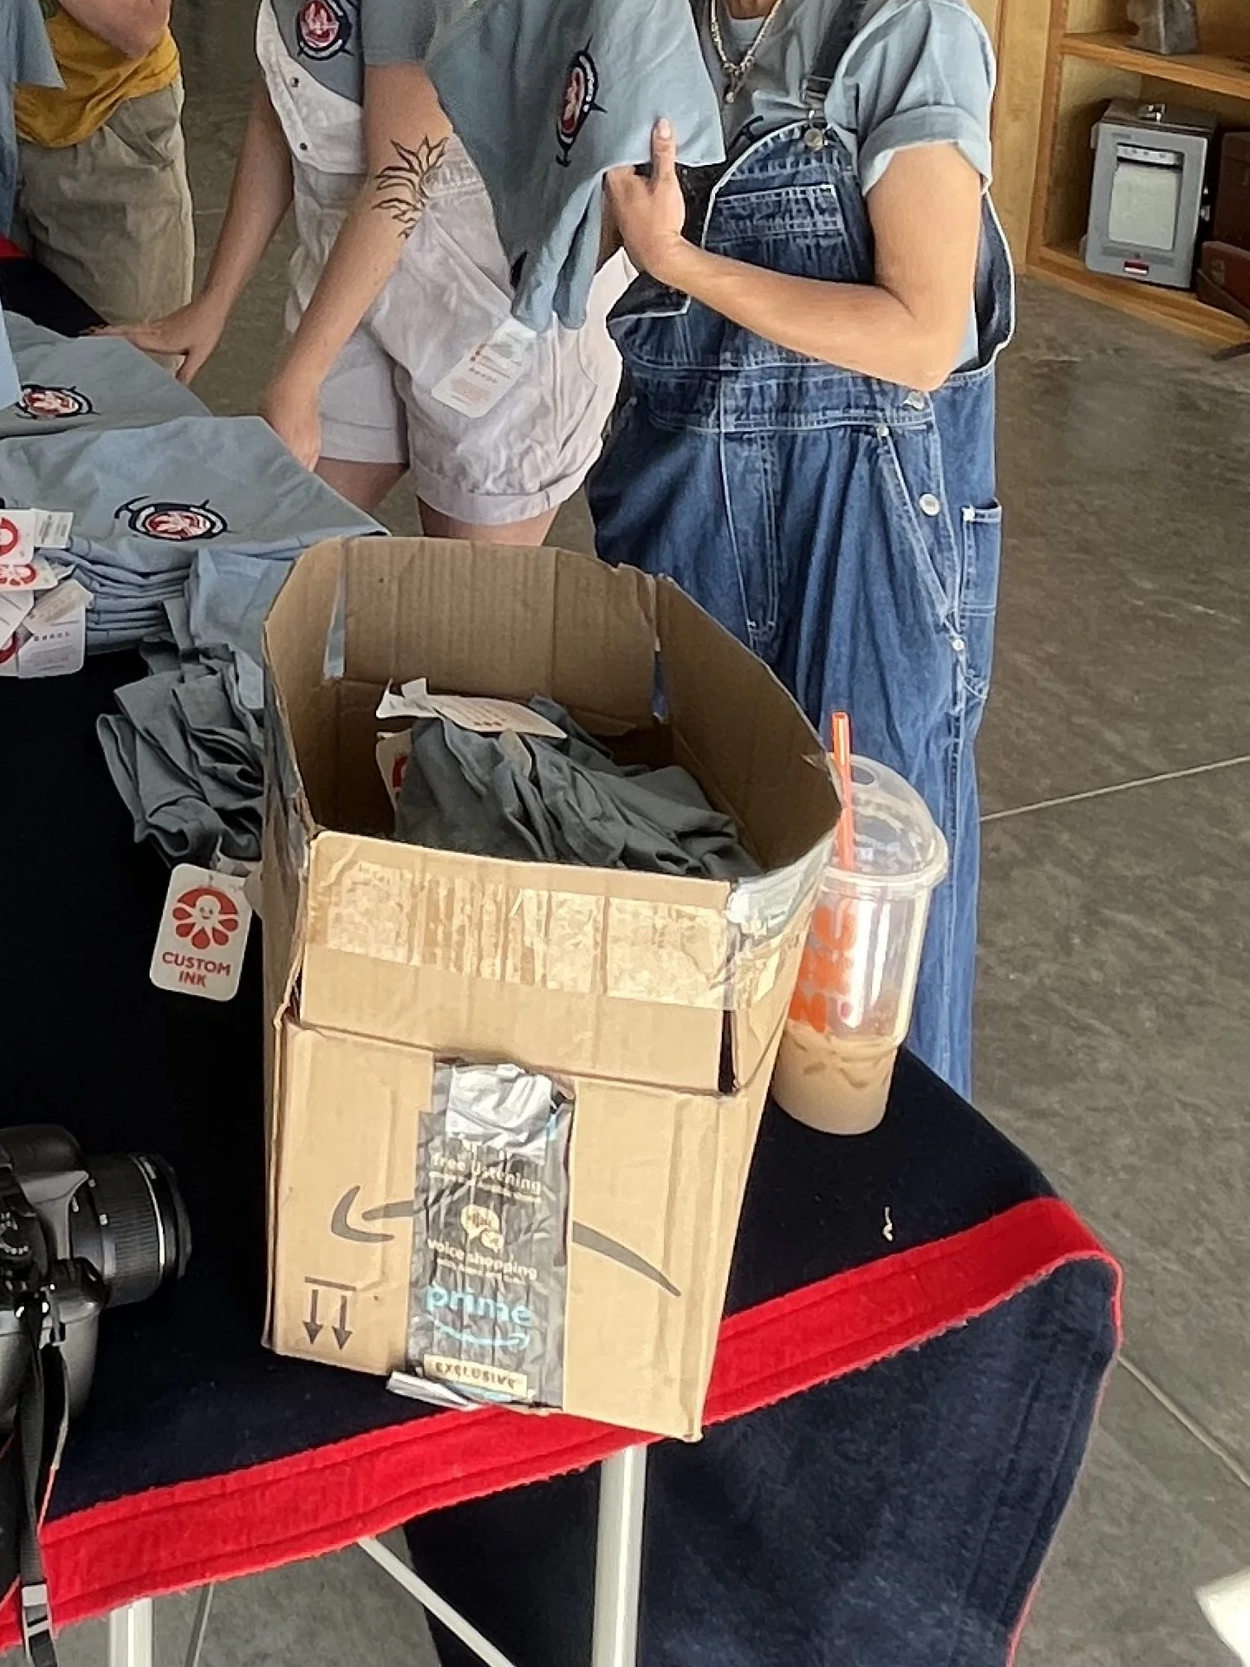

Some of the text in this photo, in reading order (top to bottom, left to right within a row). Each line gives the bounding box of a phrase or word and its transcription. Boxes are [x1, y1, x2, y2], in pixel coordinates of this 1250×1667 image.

[161, 951, 232, 977] CUSTOM
[178, 970, 208, 988] INK
[432, 1152, 466, 1172] free
[426, 1238, 466, 1260] voice
[467, 1252, 538, 1281] shopping
[424, 1284, 532, 1324] prime
[434, 1361, 517, 1390] EXCLUSIVE
